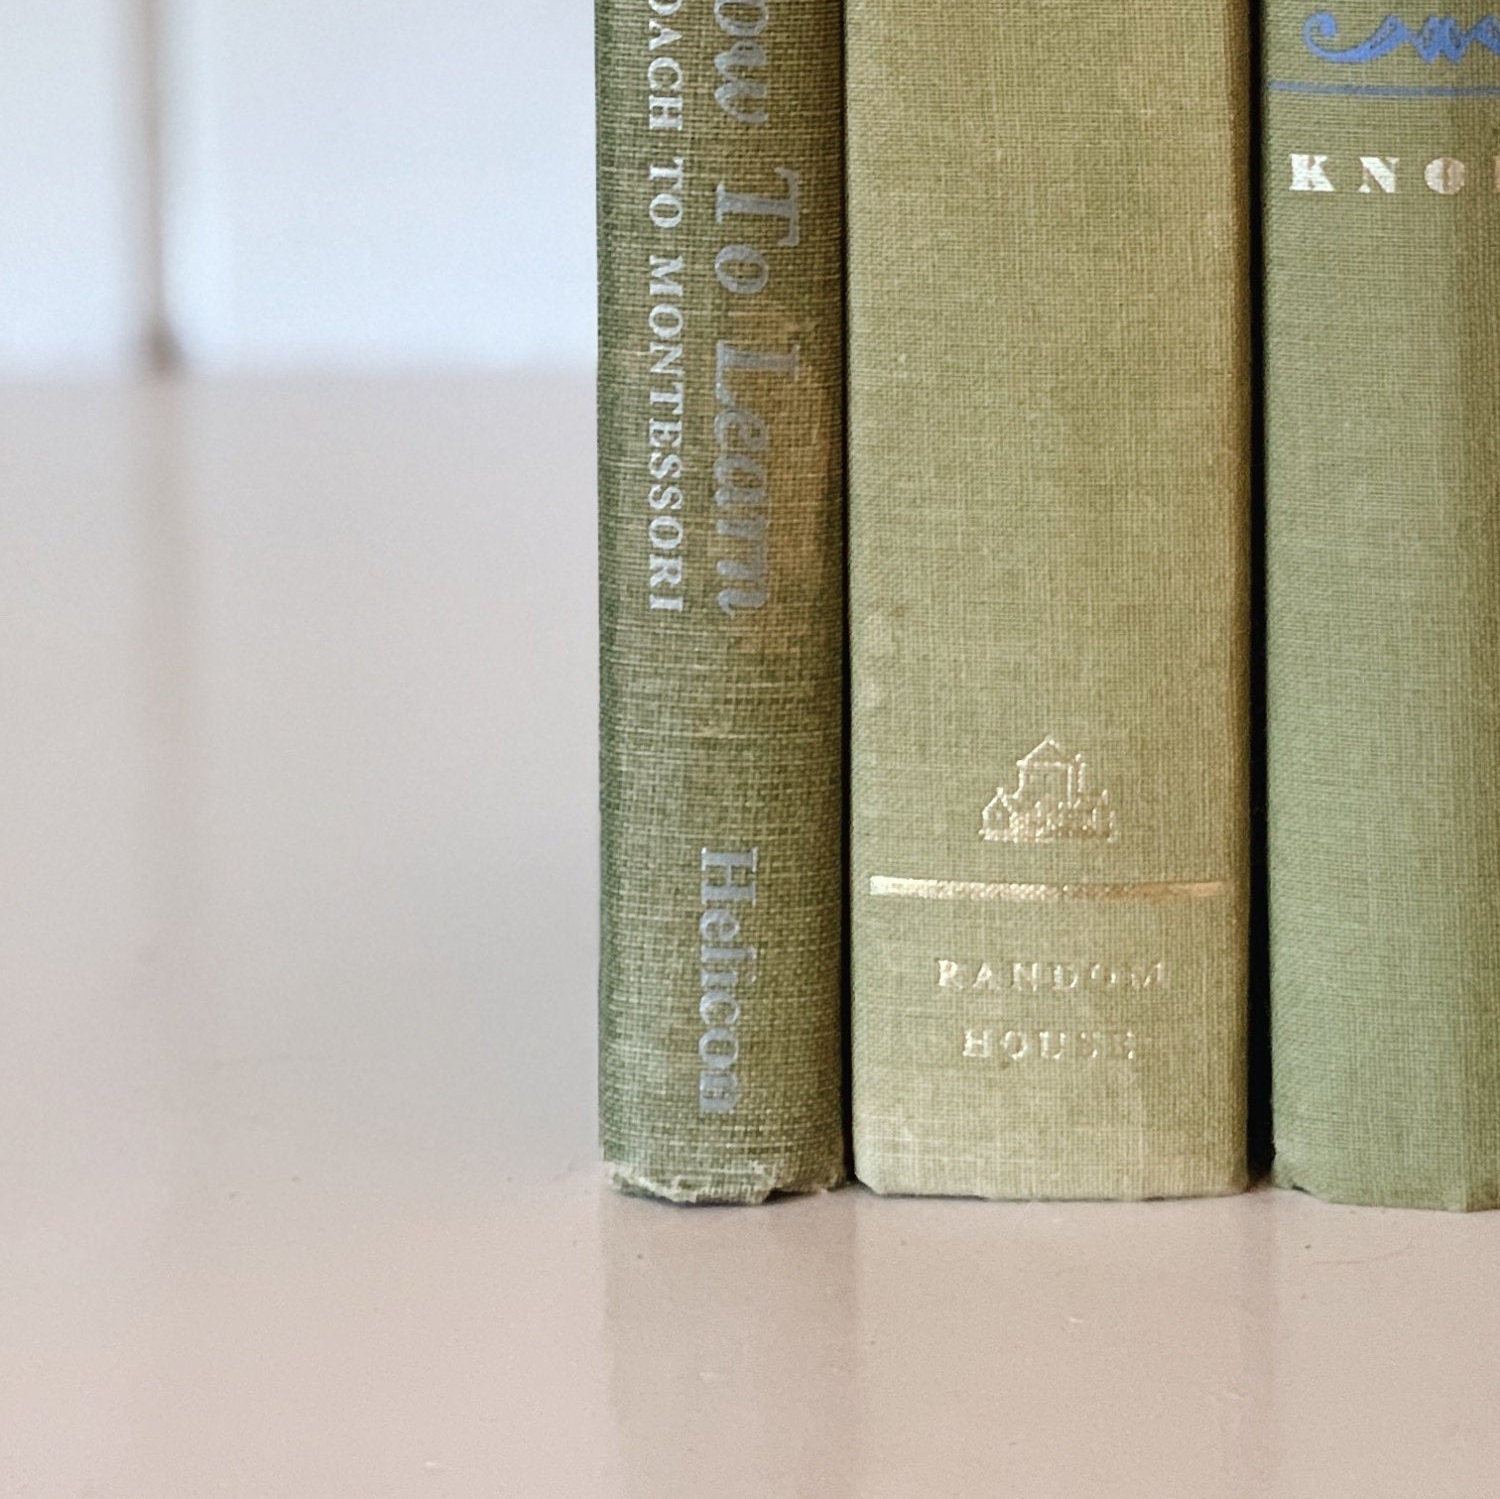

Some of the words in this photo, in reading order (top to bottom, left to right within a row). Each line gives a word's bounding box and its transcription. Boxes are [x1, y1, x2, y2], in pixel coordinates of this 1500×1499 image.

[648, 156, 685, 230] TO
[713, 165, 800, 296] To
[647, 253, 685, 615] MONTESSORI
[712, 338, 800, 615] Learn
[698, 845, 760, 1116] Helicon
